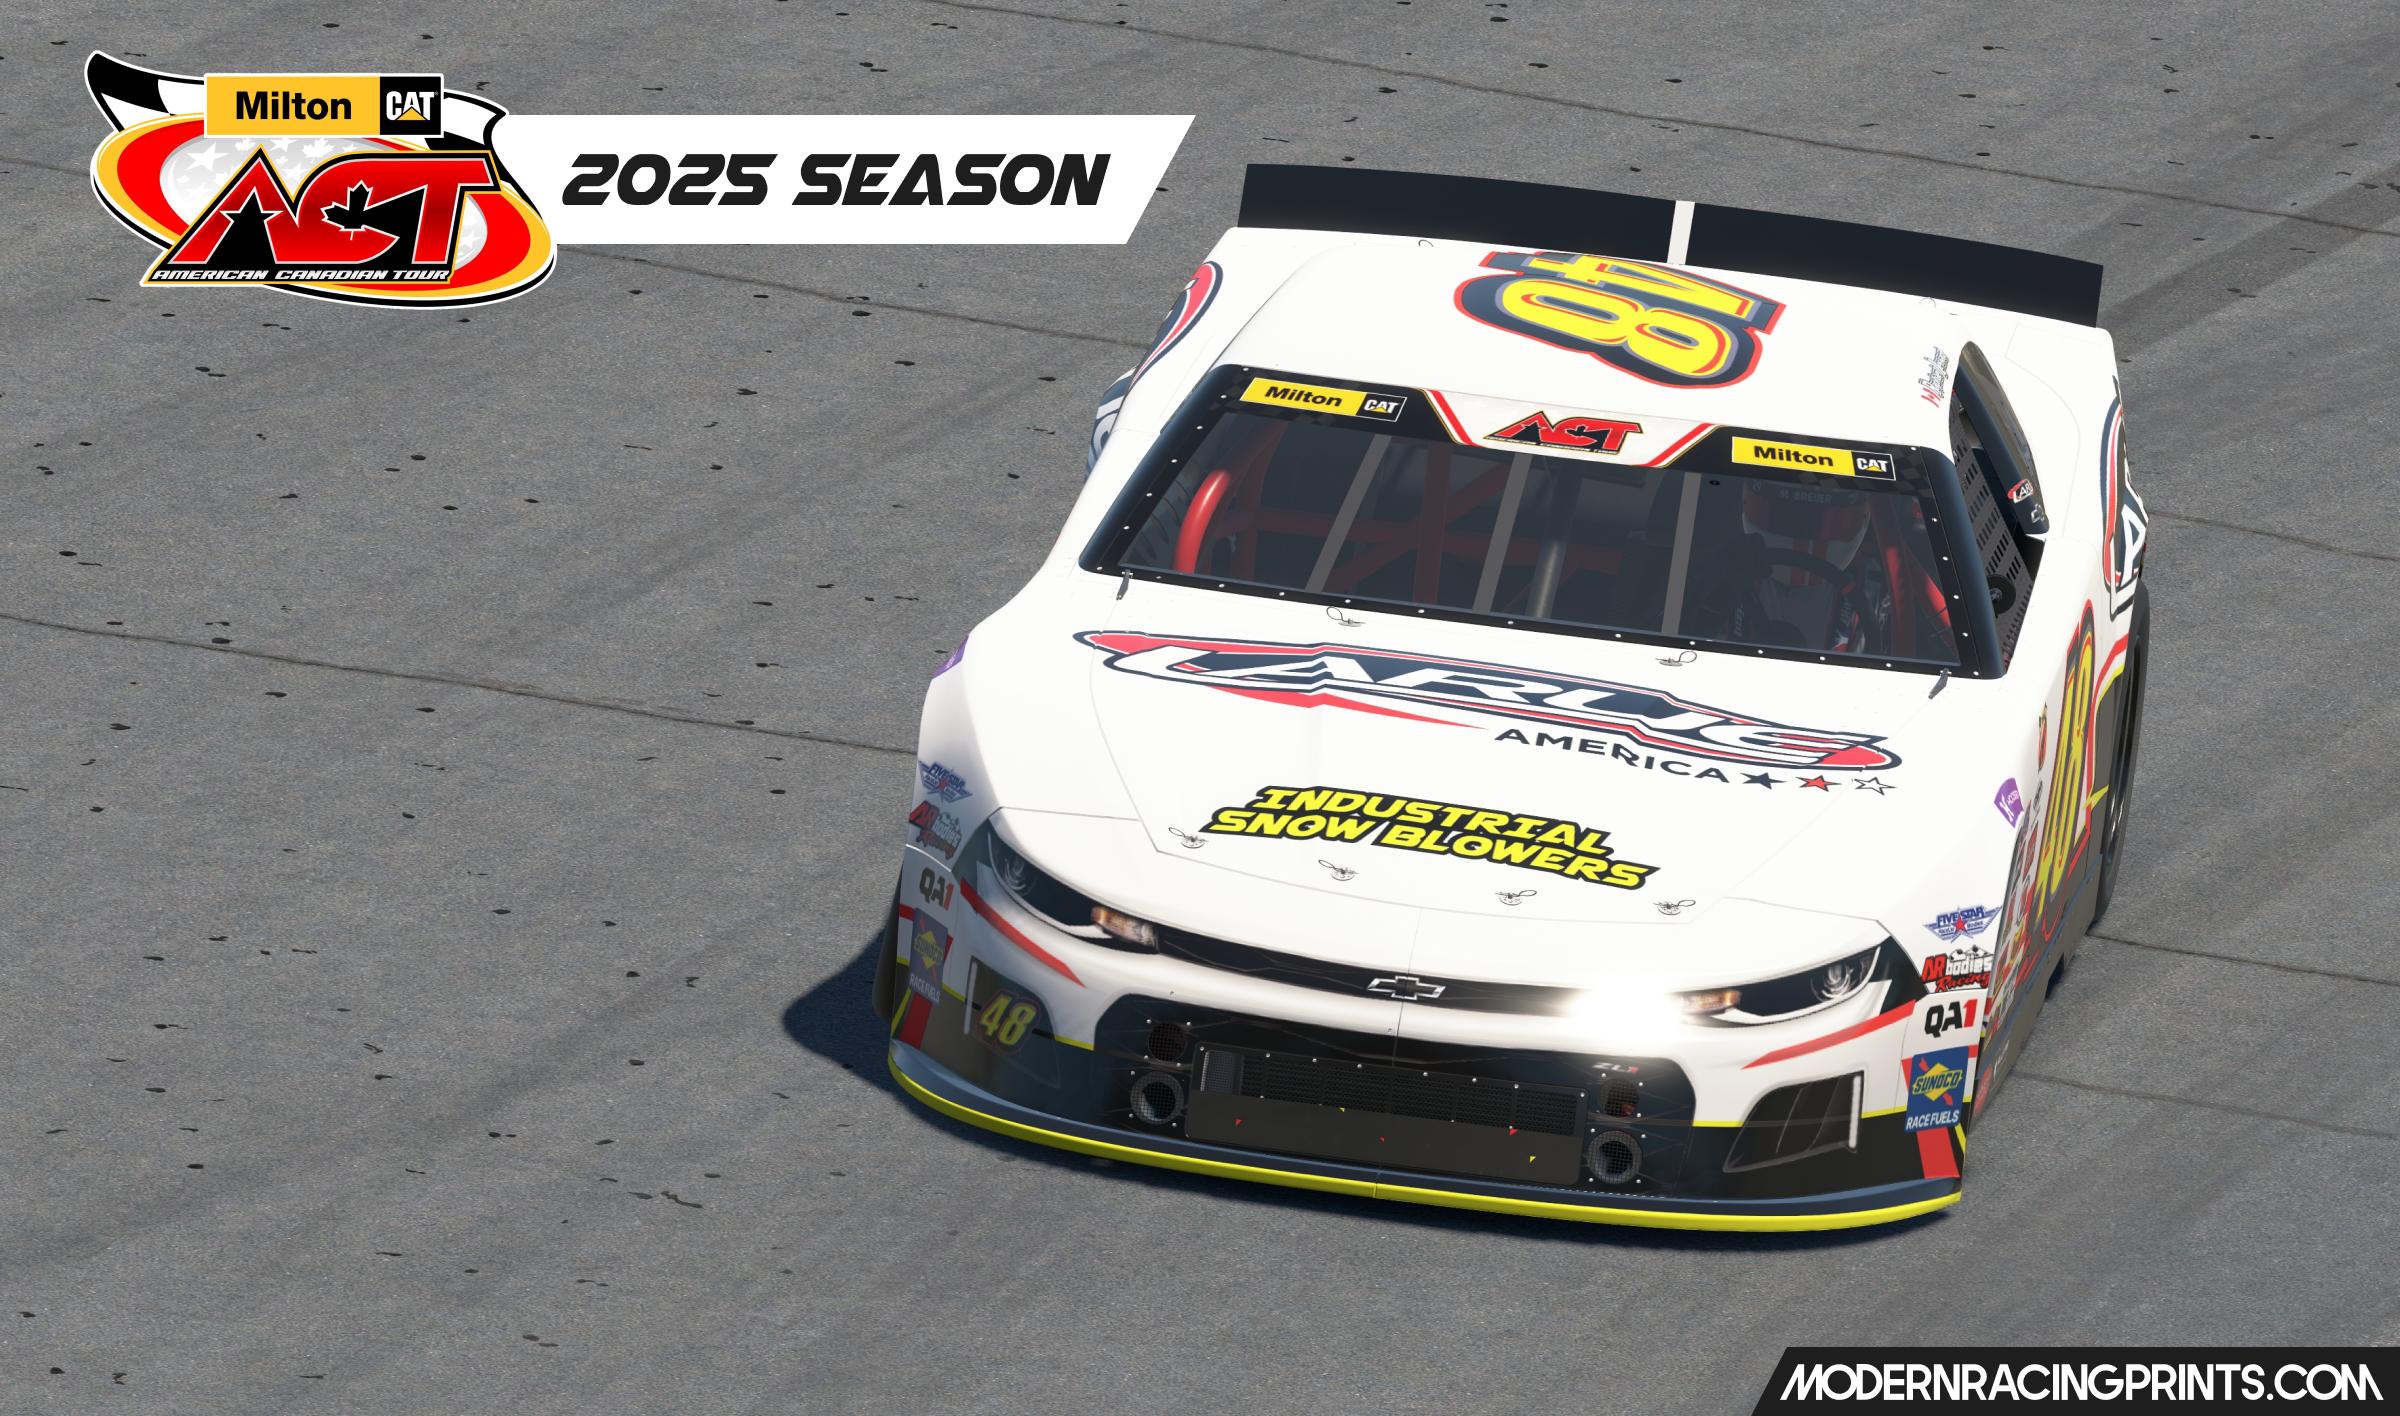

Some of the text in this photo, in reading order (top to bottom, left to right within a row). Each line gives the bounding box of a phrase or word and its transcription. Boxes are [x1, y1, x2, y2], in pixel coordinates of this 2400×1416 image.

[1263, 385, 1343, 408] Milton
[1363, 398, 1399, 414] CAT
[1491, 410, 1643, 453] ACT
[1752, 444, 1834, 467] Milton
[1855, 456, 1889, 474] CAT
[1494, 727, 1731, 784] AMERICA
[1251, 786, 1613, 856] INDUSTRIAL
[1208, 809, 1650, 888] SNOW BLOWERS
[919, 867, 954, 911] QA1
[1936, 905, 1985, 928] FIVE STAR
[980, 993, 1037, 1046] 48
[1924, 999, 1978, 1038] QA1
[1913, 1070, 1962, 1094] SUNOCO
